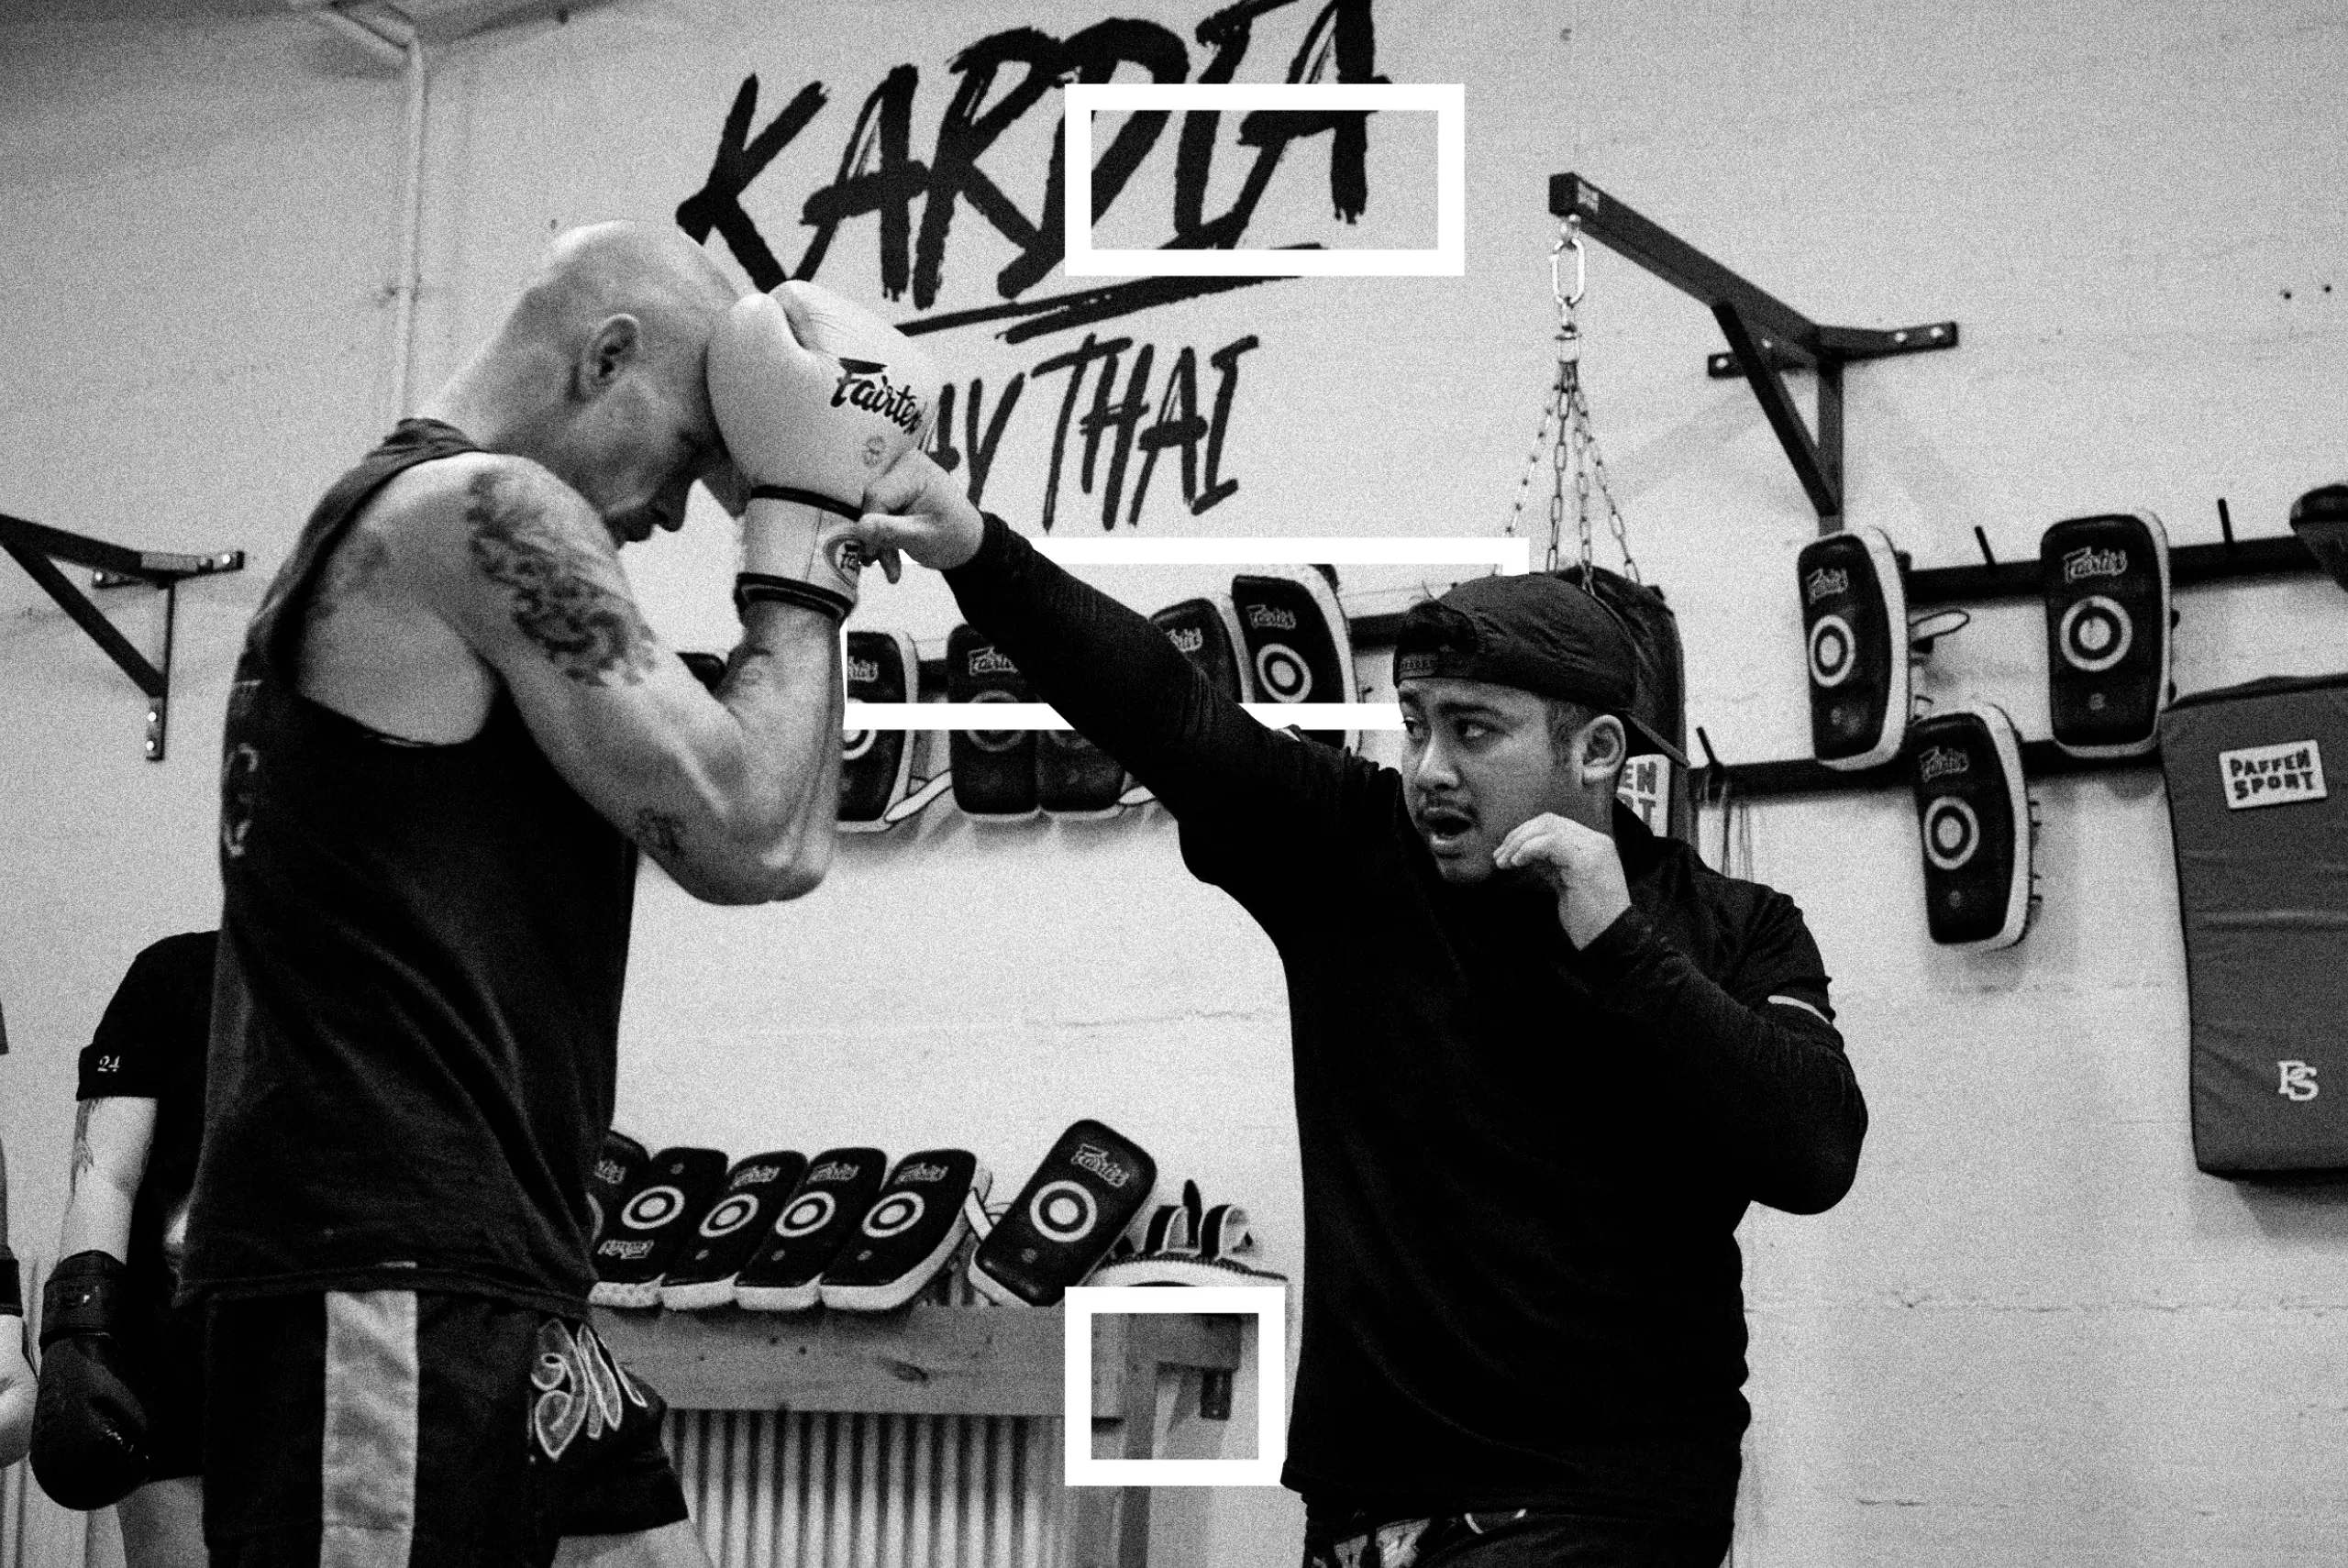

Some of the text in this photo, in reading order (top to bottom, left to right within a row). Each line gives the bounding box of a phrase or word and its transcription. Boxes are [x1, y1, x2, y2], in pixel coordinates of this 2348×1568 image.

[1032, 333, 1259, 533] THAI
[2229, 747, 2312, 778] PAFFEN
[2232, 770, 2315, 801] SPORT
[96, 1055, 121, 1073] 24
